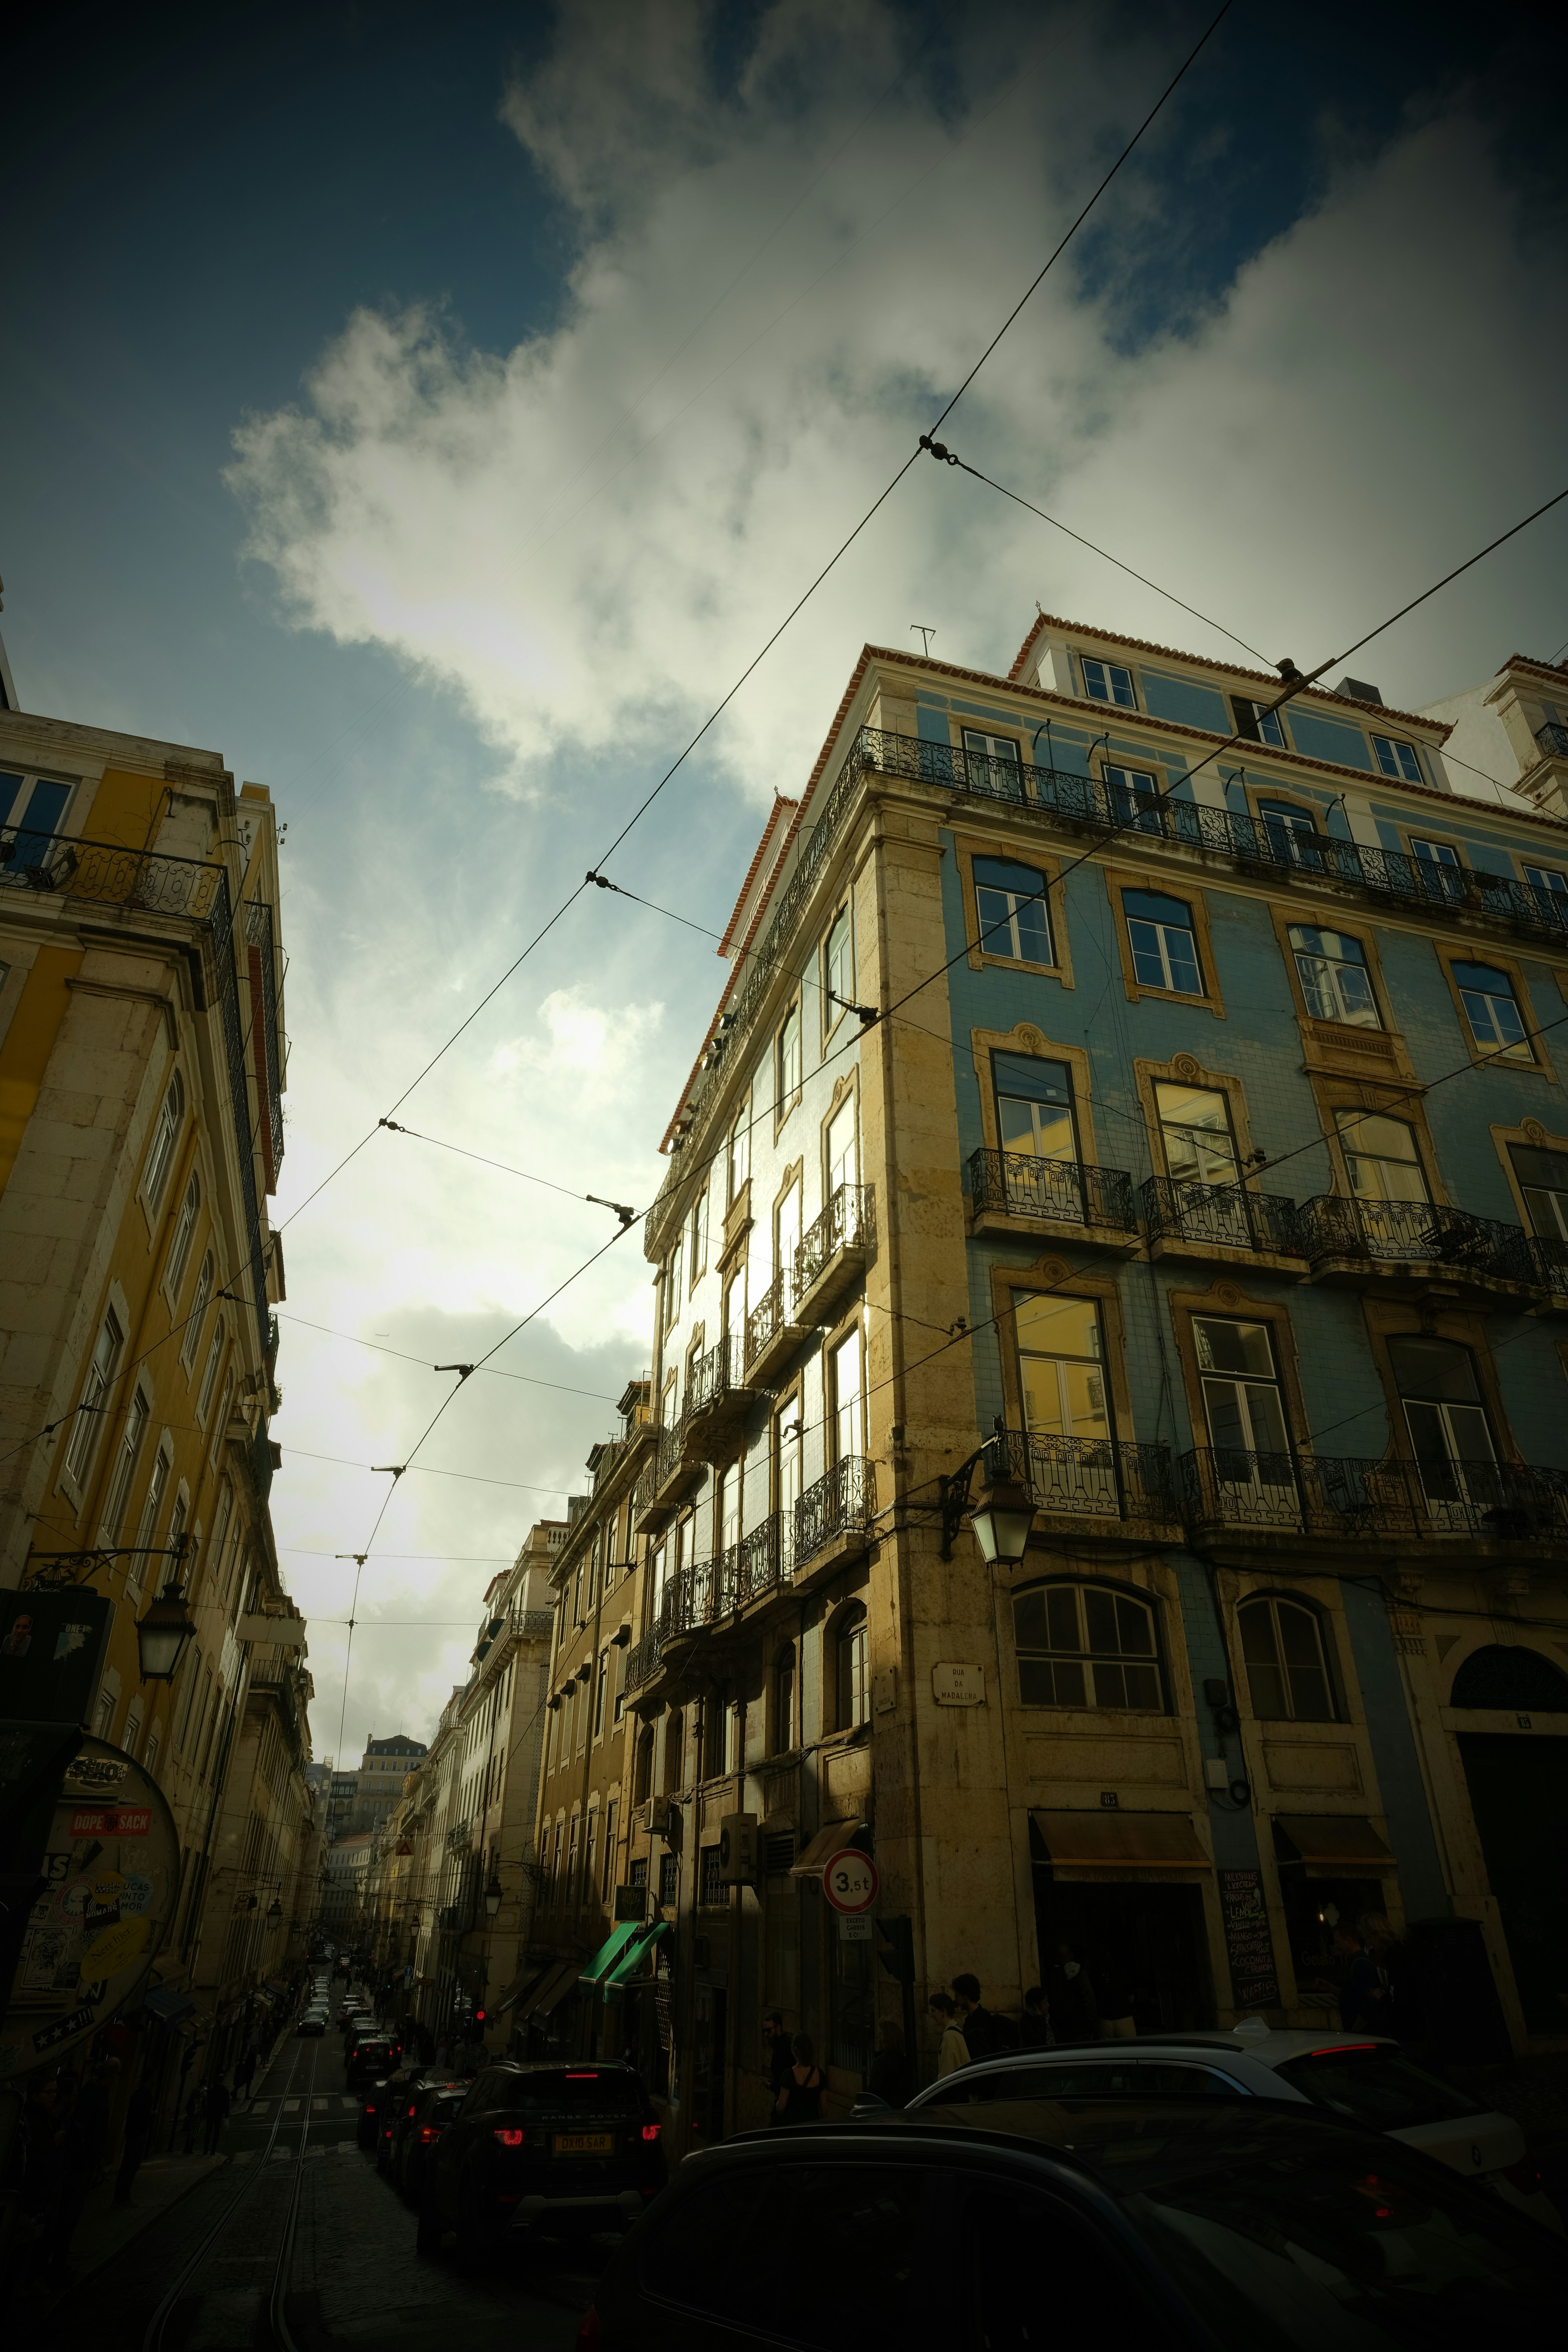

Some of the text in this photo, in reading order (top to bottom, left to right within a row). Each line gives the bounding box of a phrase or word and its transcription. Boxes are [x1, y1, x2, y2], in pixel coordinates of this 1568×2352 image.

[942, 1692, 977, 1700] MADALENA
[1521, 1718, 1529, 1727] 85
[1105, 1795, 1115, 1805] 83
[74, 1815, 148, 1830] DOPE SACK
[1225, 1872, 1257, 1882] MILKSHAKES
[124, 1883, 149, 1891] UCAS
[121, 1902, 142, 1911] MOR
[86, 1905, 117, 1919] NOMADS
[1230, 1905, 1251, 1919] LEMON
[1230, 1920, 1250, 1929] VANILLA
[1231, 1932, 1252, 1942] MANGO
[90, 1943, 113, 1962] Nett
[112, 1927, 133, 1944] hier.
[1234, 1955, 1267, 1966] COCONUT
[1302, 1951, 1335, 1966] Gelato
[1238, 1981, 1277, 2002] WAFFLES
[587, 2136, 605, 2148] SAR
